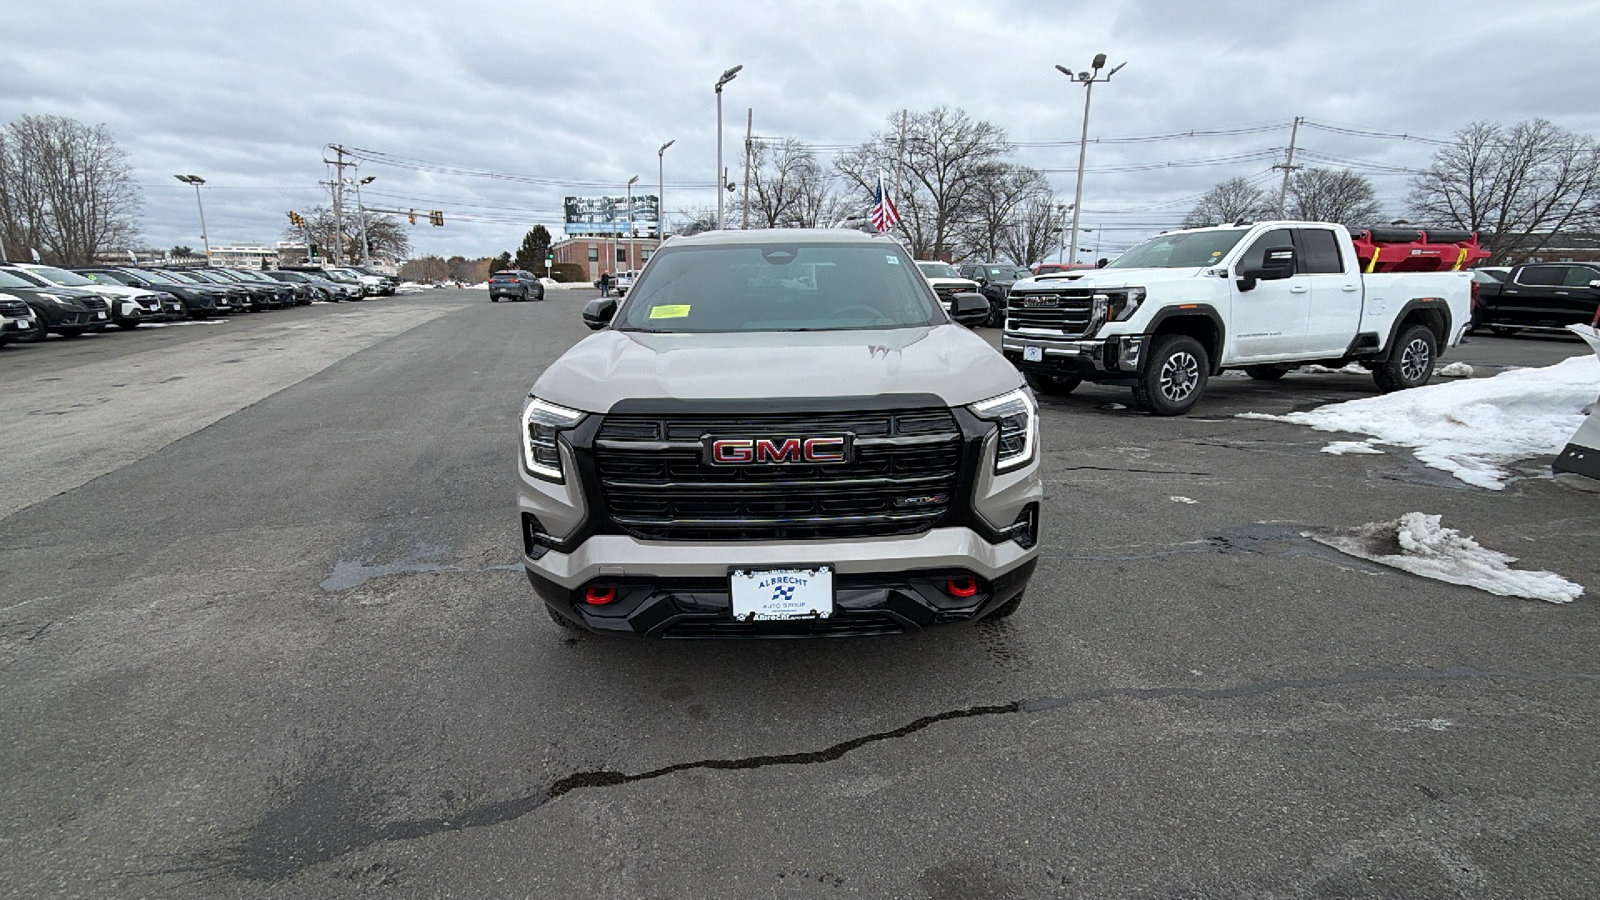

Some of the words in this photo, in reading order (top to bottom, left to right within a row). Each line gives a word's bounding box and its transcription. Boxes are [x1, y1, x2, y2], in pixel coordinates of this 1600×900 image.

[713, 437, 844, 463] GMC
[758, 576, 808, 589] ALBRECHT
[753, 613, 791, 621] Albrecht
